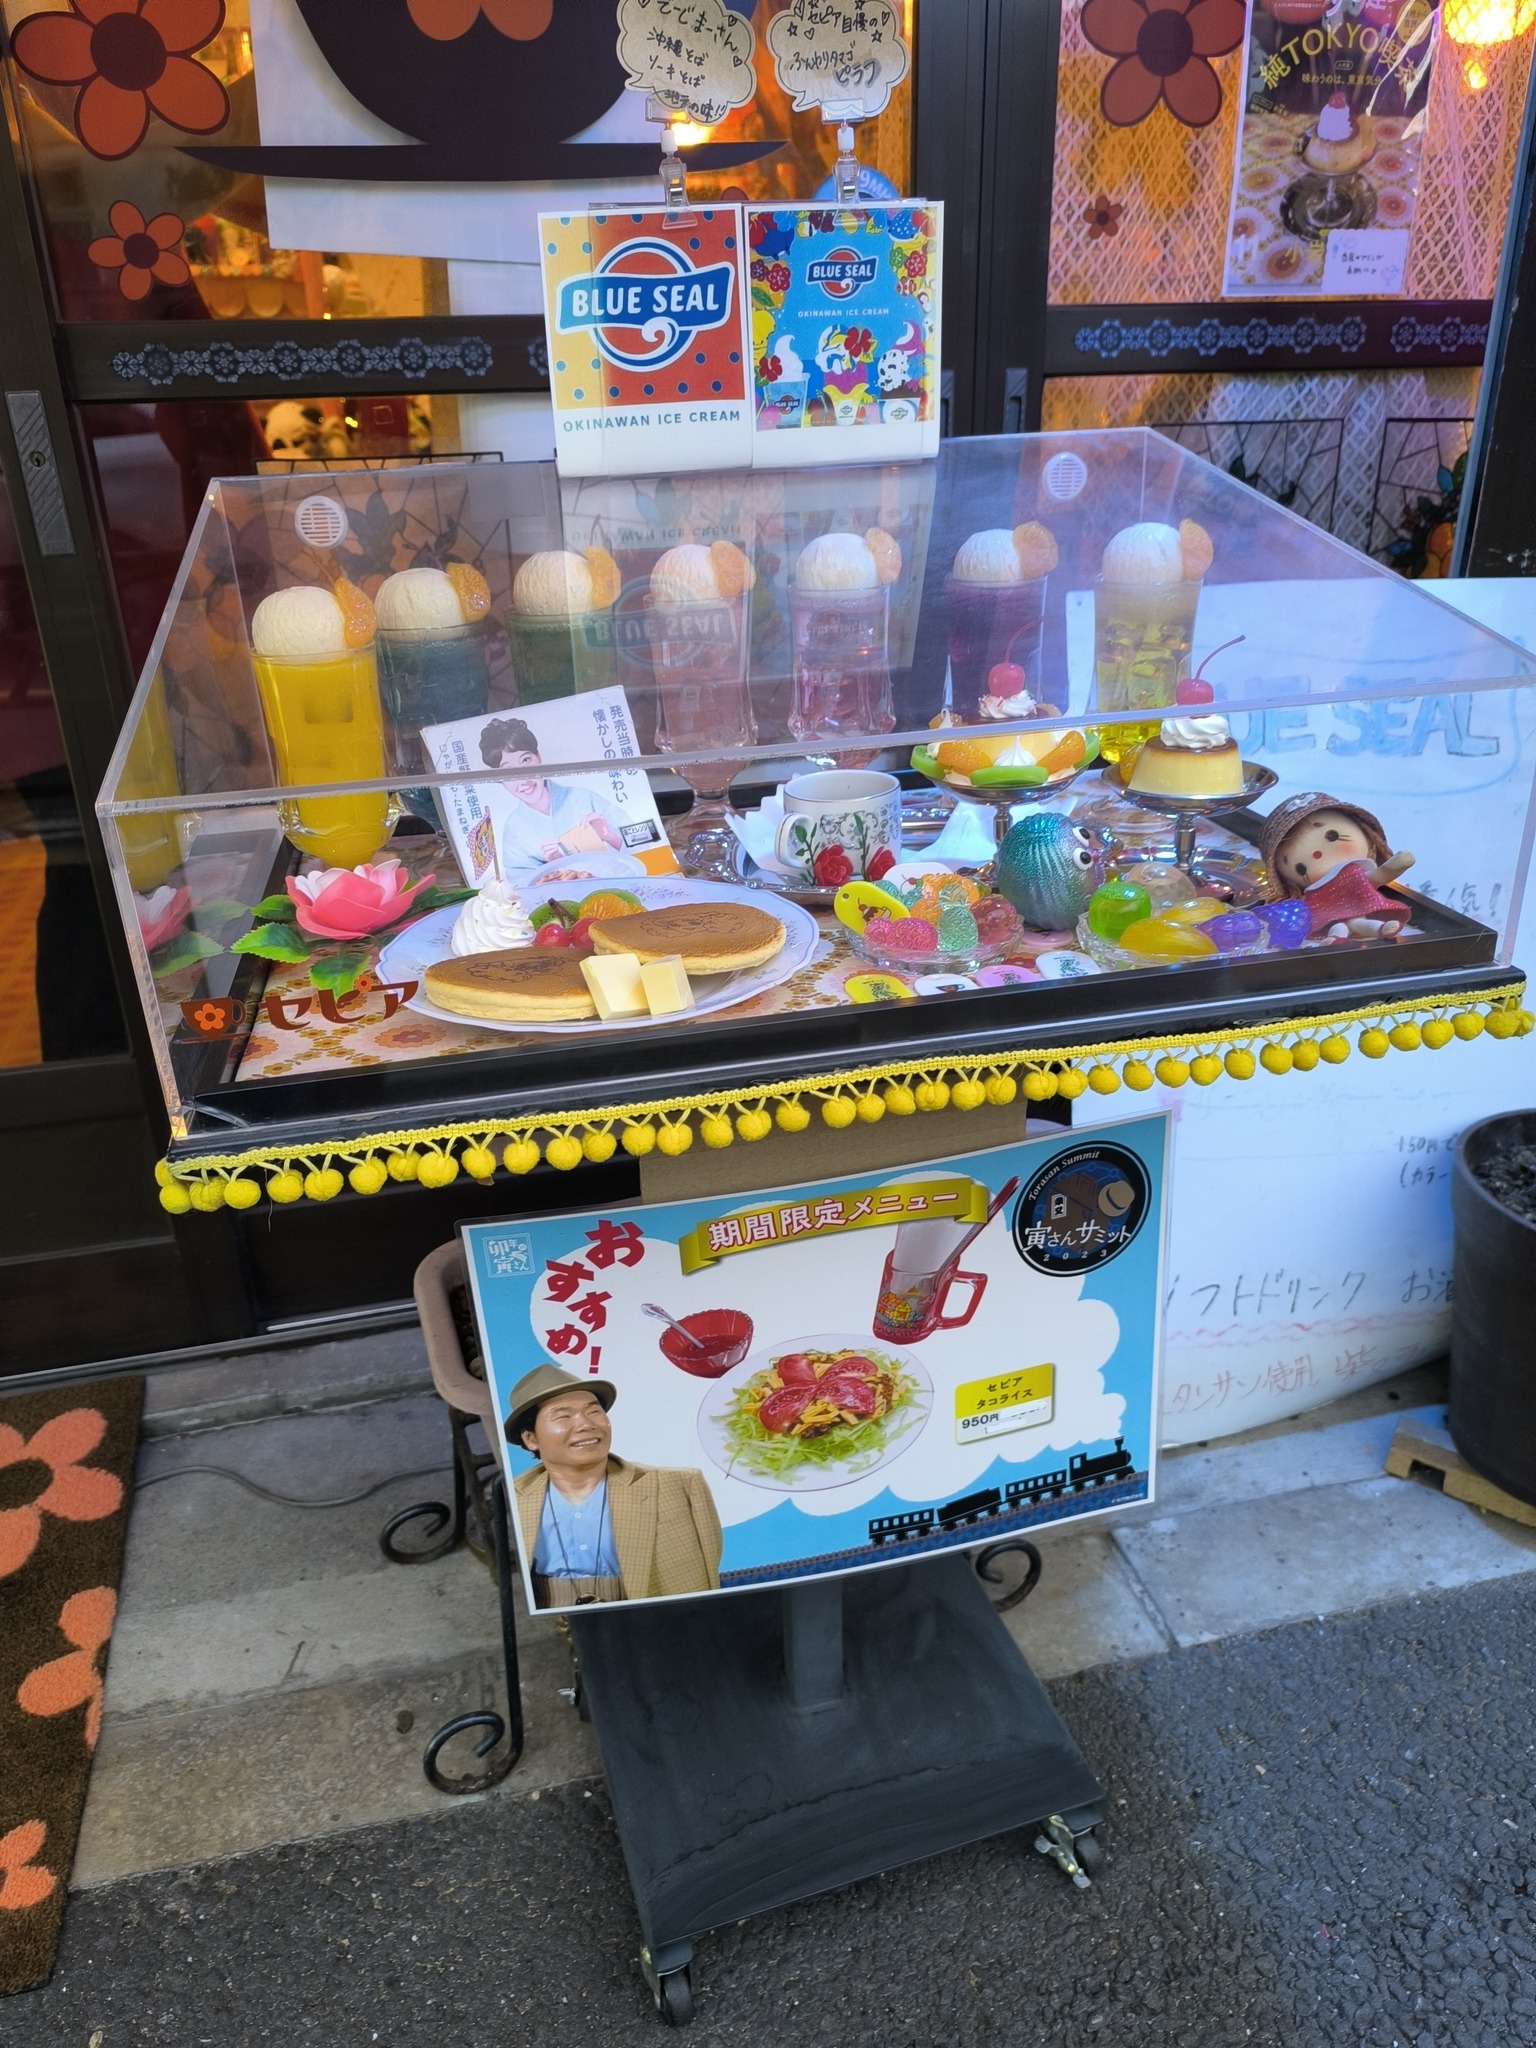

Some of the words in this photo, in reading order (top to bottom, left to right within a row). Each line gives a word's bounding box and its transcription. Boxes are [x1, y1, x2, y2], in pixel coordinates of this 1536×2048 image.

[807, 5, 878, 33] セピア自慢の
[646, 26, 709, 66] 沖縄そば
[790, 40, 856, 71] ふんわりタマゴ
[649, 54, 706, 89] ソーキそば
[833, 58, 881, 88] ピラフ
[812, 264, 842, 278] BLUE
[844, 263, 873, 277] SEAL
[572, 286, 642, 318] BLUE
[652, 283, 719, 314] SEAL
[797, 310, 843, 318] OKINAWAN
[846, 309, 859, 317] ICE
[861, 308, 890, 316] CREAM
[563, 414, 650, 432] OKINAWAN
[657, 413, 682, 425] ICE
[689, 410, 740, 422] CREAM
[1326, 674, 1500, 757] SEAL
[260, 976, 419, 1030] セピア
[1029, 1166, 1060, 1201] Torasan
[1062, 1150, 1100, 1168] Summit
[708, 1191, 960, 1250] 期間限定メニュー
[1022, 1218, 1132, 1252] 寅さんサミット
[493, 1256, 530, 1274] 寅さん
[543, 1219, 645, 1375] おすすめ!
[976, 1388, 1034, 1410] タコライス
[961, 1412, 1000, 1430] 950円
